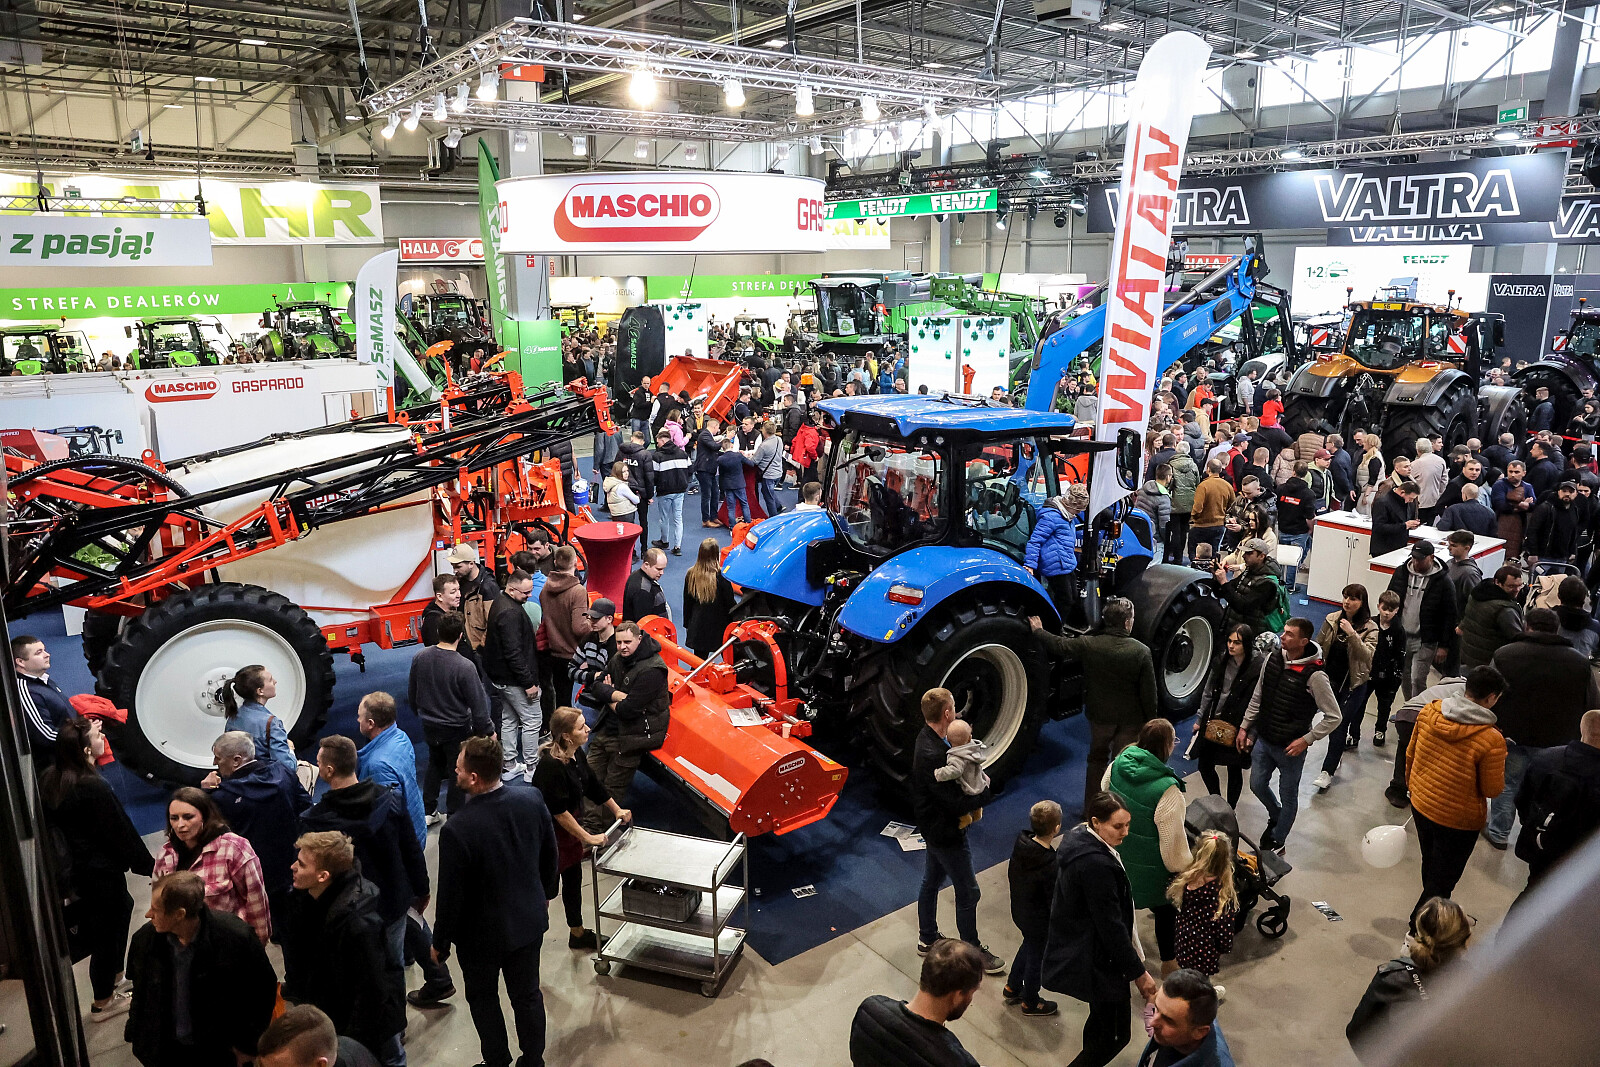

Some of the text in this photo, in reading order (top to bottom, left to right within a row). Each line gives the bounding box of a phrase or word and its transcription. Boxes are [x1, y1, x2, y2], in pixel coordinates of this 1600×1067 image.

[930, 191, 990, 212] FENDT
[1313, 169, 1520, 221] VALTRA
[572, 194, 711, 217] MASCHIO
[859, 198, 910, 216] FENDT
[10, 227, 154, 260] z pasją!
[402, 243, 440, 254] HALA
[1403, 255, 1449, 264] FENDT
[1103, 122, 1179, 424] WIATAN
[732, 281, 811, 291] STREFA DEAL
[1493, 284, 1545, 297] VALTRA
[12, 292, 219, 311] STREFA DEALERÓW
[370, 287, 384, 363] SaMASZ
[154, 377, 304, 394] MASCHIO GASPARDO
[779, 759, 804, 773] MASCHIO
